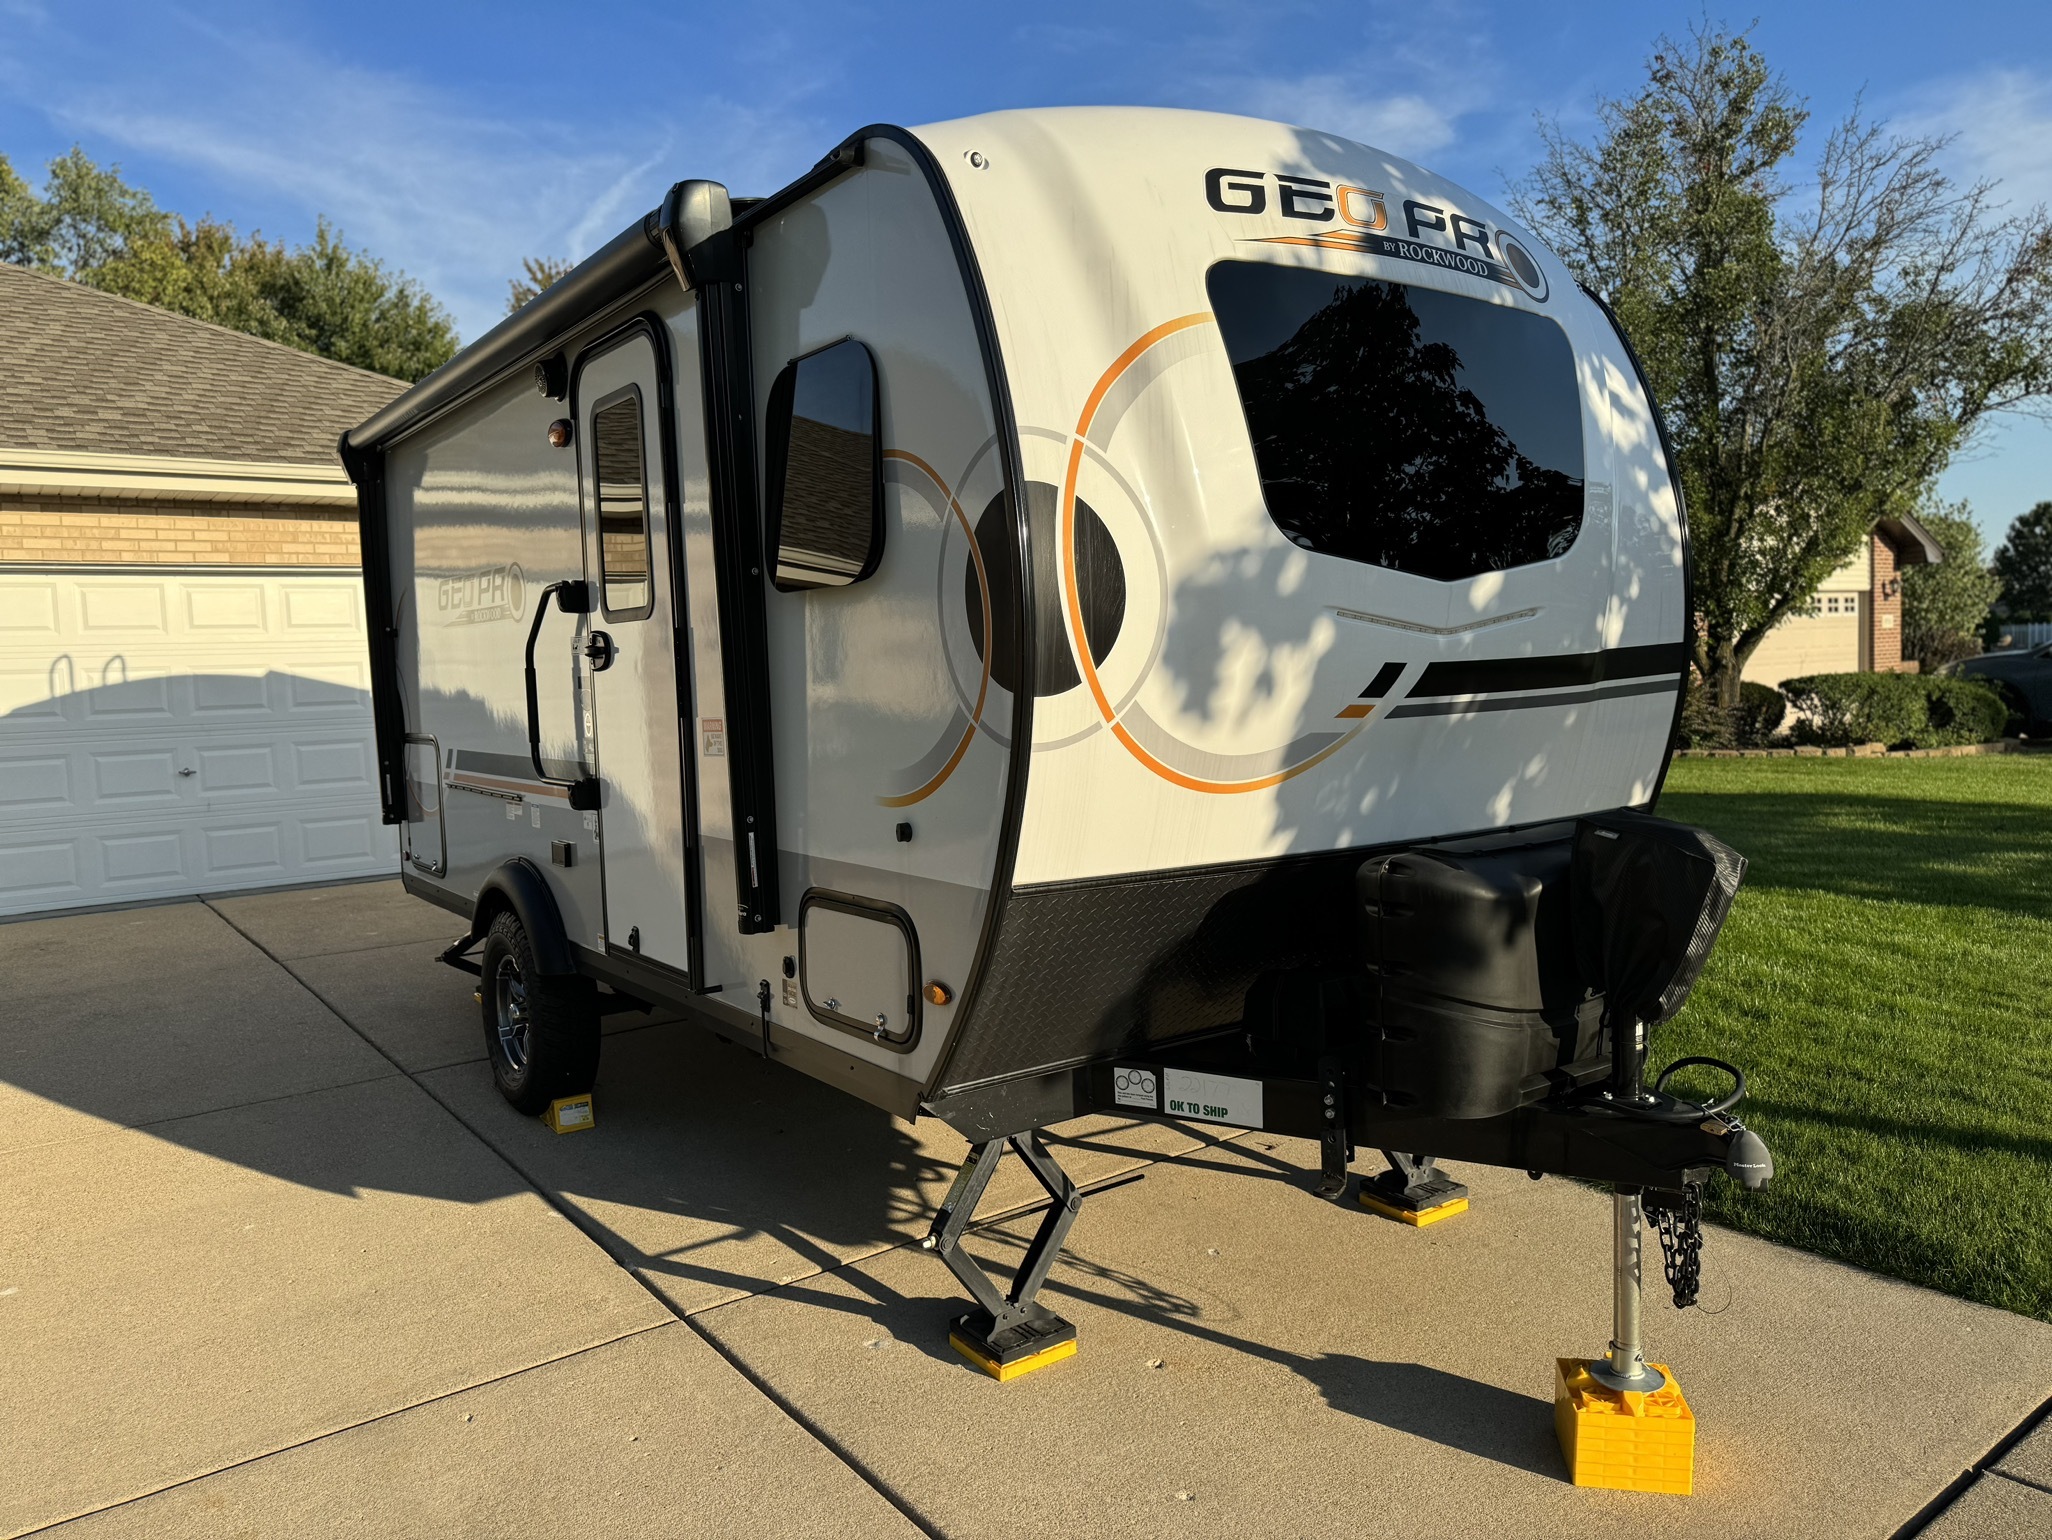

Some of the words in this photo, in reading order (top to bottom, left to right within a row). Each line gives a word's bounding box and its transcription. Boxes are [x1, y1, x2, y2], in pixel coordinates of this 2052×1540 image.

[1204, 167, 1388, 231] GEO
[1383, 240, 1397, 252] BY
[1399, 243, 1489, 276] ROCKWOOD
[438, 575, 475, 611] GEO
[1170, 1100, 1185, 1112] OK
[1187, 1102, 1200, 1114] TO
[1203, 1104, 1228, 1118] SHIP
